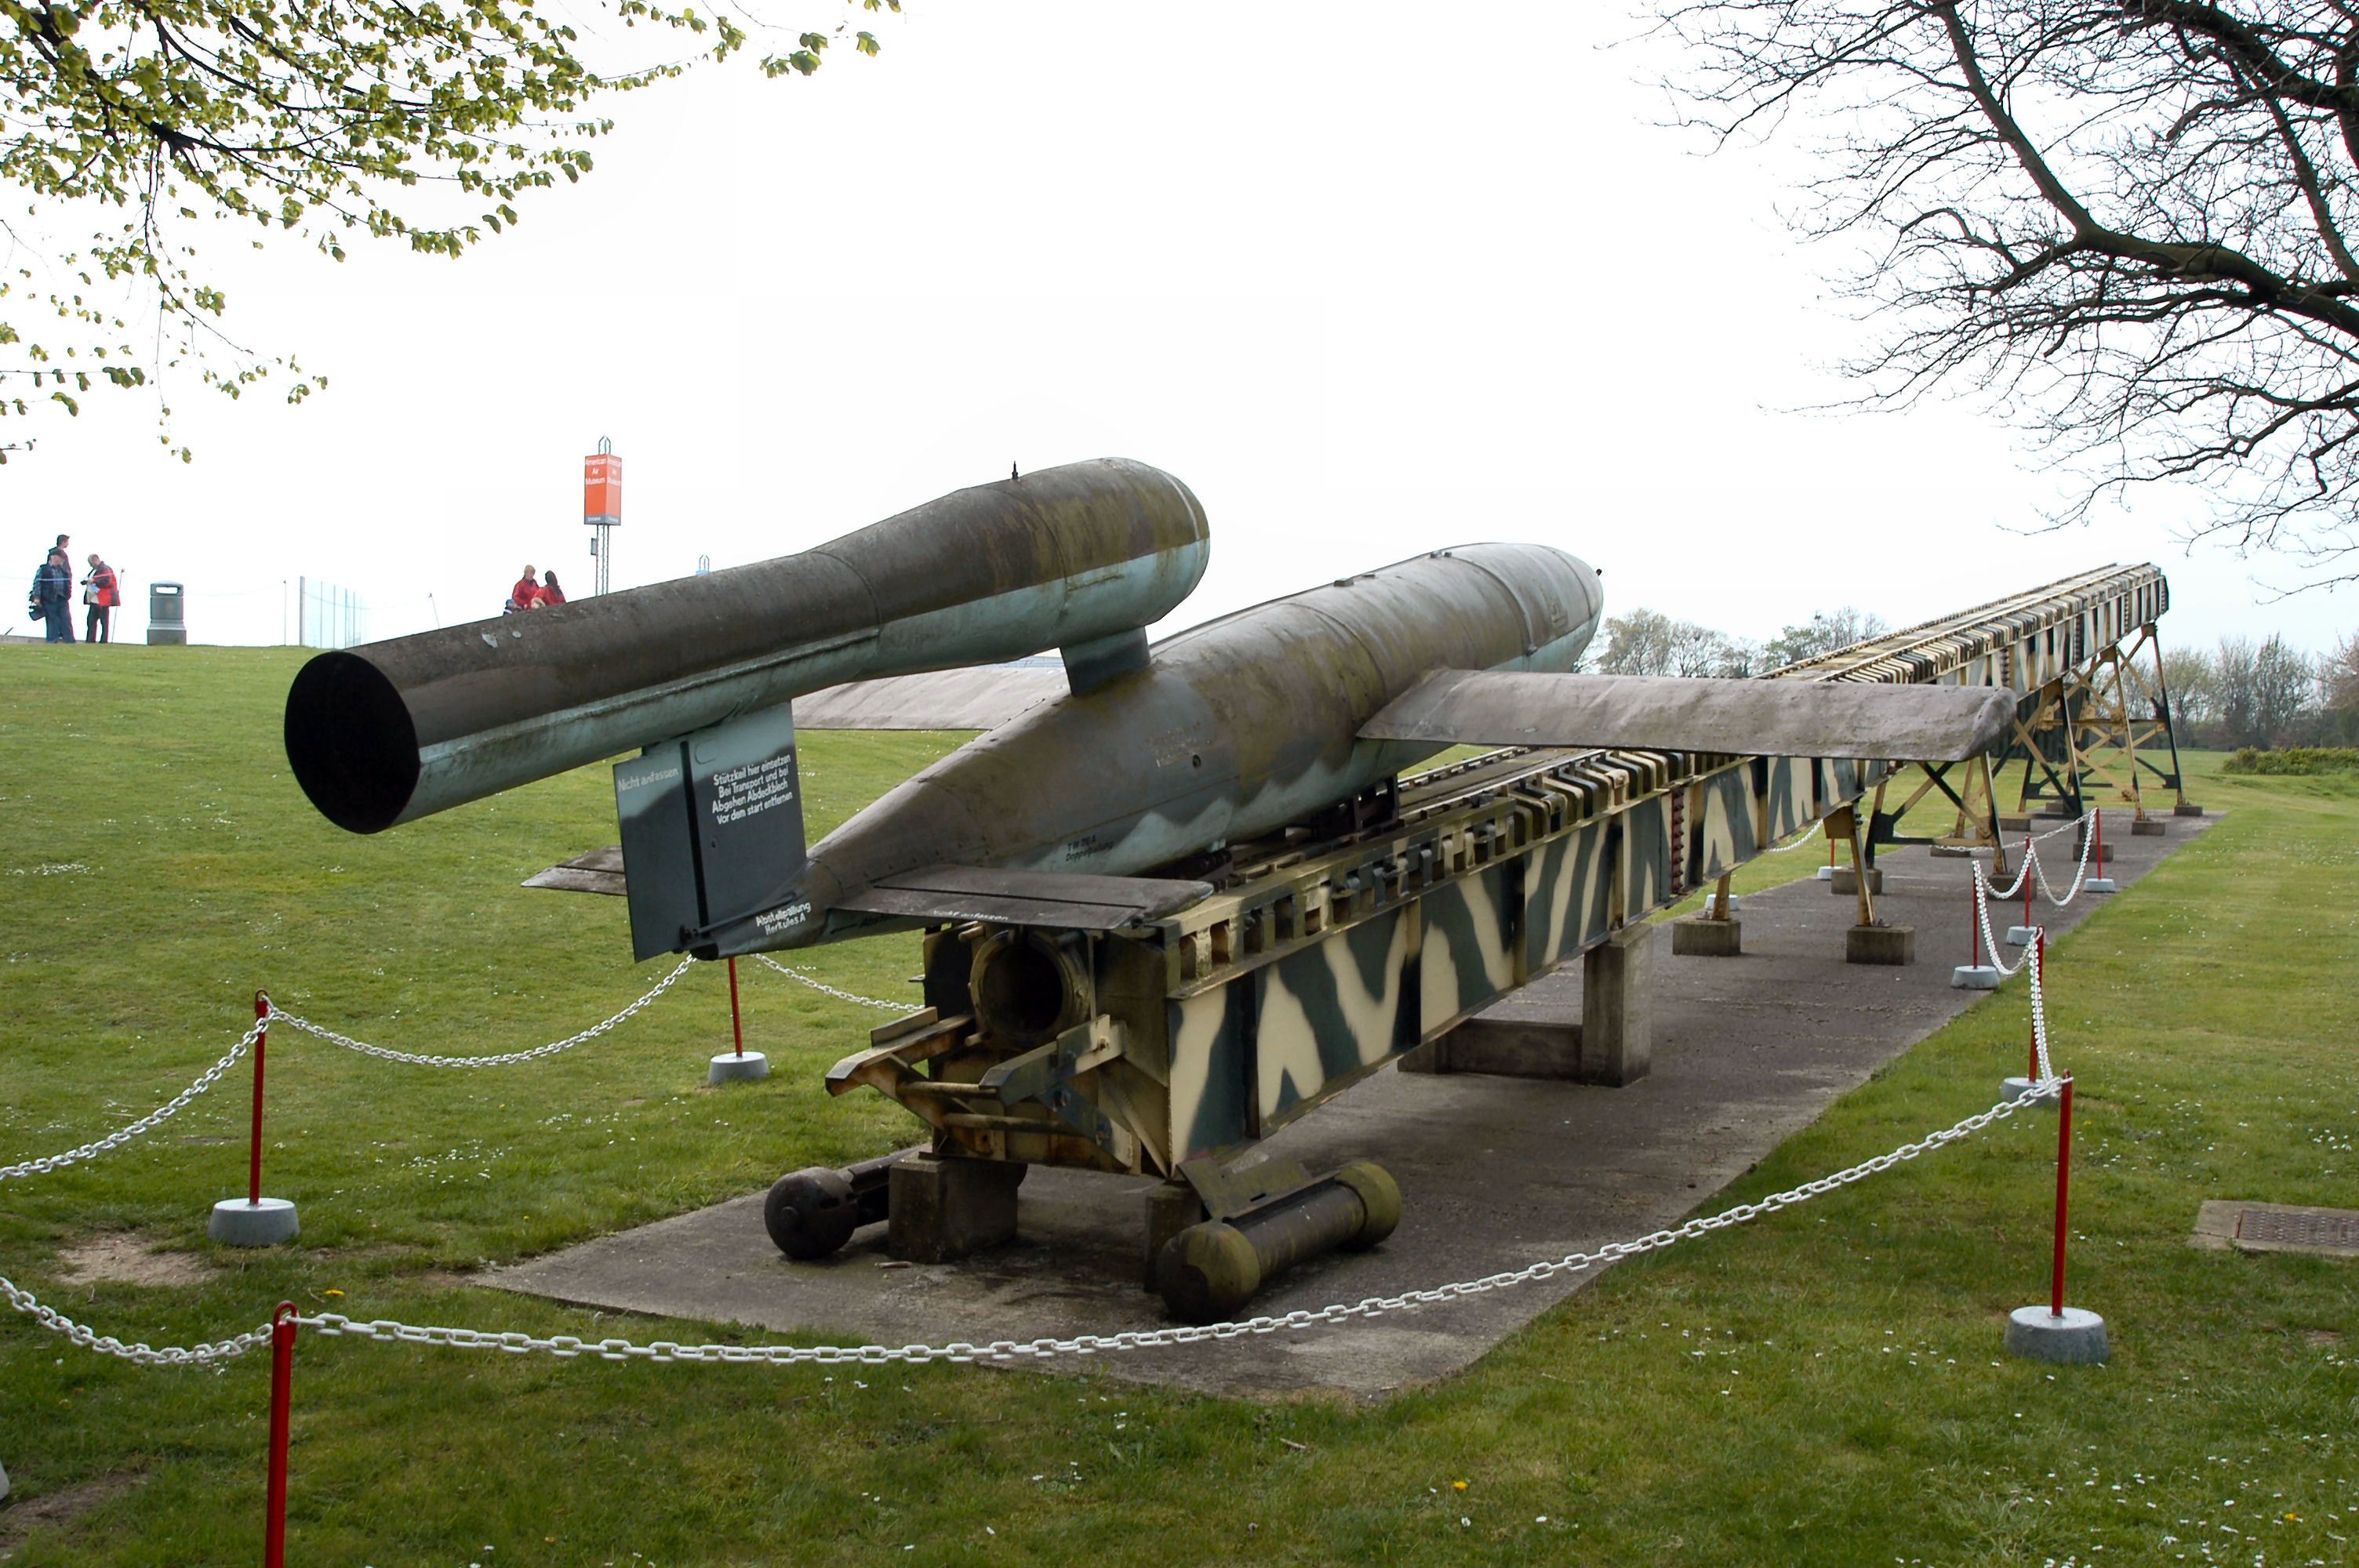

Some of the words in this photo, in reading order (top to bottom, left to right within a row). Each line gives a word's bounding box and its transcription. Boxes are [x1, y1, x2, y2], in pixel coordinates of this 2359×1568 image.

[747, 764, 760, 776] hier
[761, 754, 791, 771] einsetzen
[618, 776, 640, 792] Nicht
[641, 768, 678, 785] anfassen
[718, 785, 732, 798] Bei
[732, 775, 764, 794] Transport
[765, 769, 777, 782] und
[779, 764, 789, 777] bei
[717, 814, 730, 825] Vor
[747, 801, 763, 815] start
[764, 791, 793, 809] entfernen
[765, 916, 799, 935] Herkules
[799, 912, 806, 923] A
